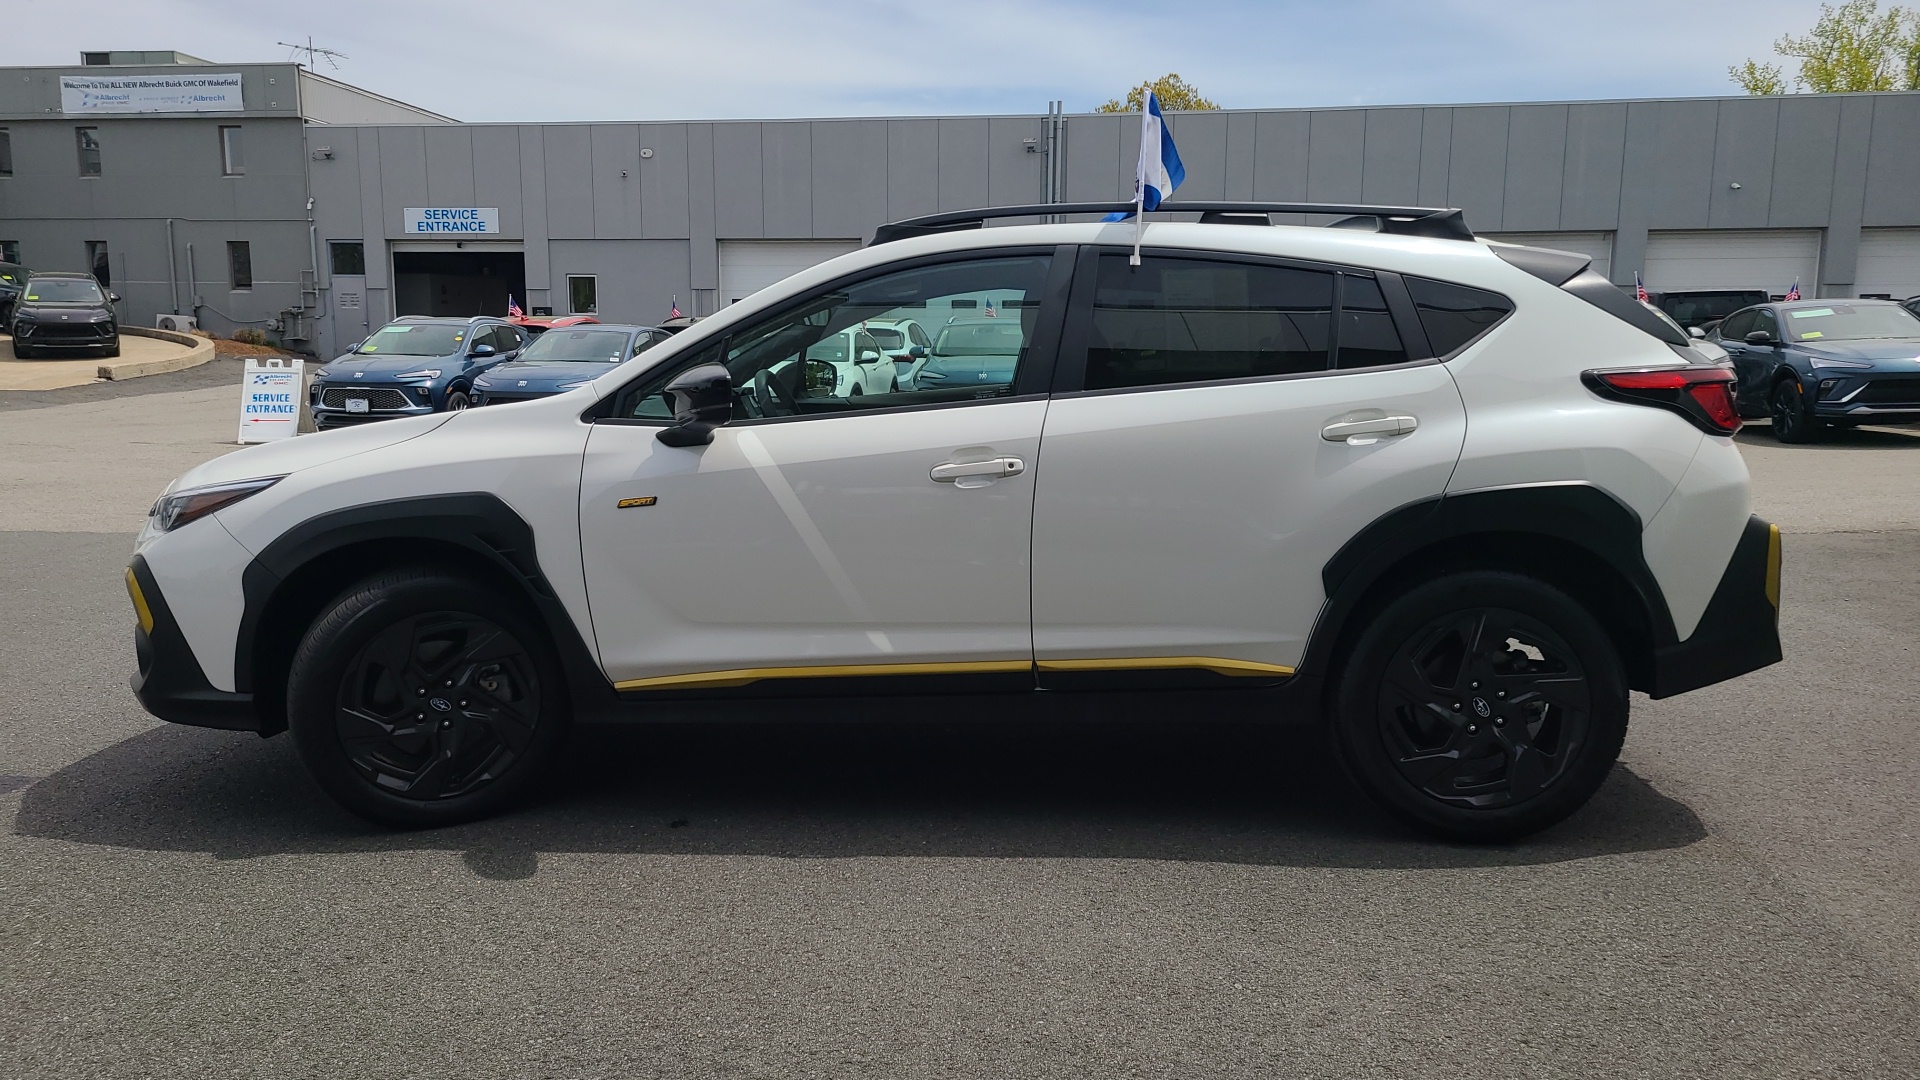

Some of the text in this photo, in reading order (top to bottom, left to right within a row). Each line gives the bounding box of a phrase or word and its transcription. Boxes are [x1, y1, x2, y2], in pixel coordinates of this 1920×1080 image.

[165, 80, 182, 88] Buick
[206, 79, 238, 87] Wakefield
[424, 209, 478, 220] SERVICE
[417, 221, 486, 232] ENTRANCE
[252, 393, 290, 402] SERVICE
[246, 404, 294, 413] ENTRANCE
[619, 497, 654, 507] SPORT
